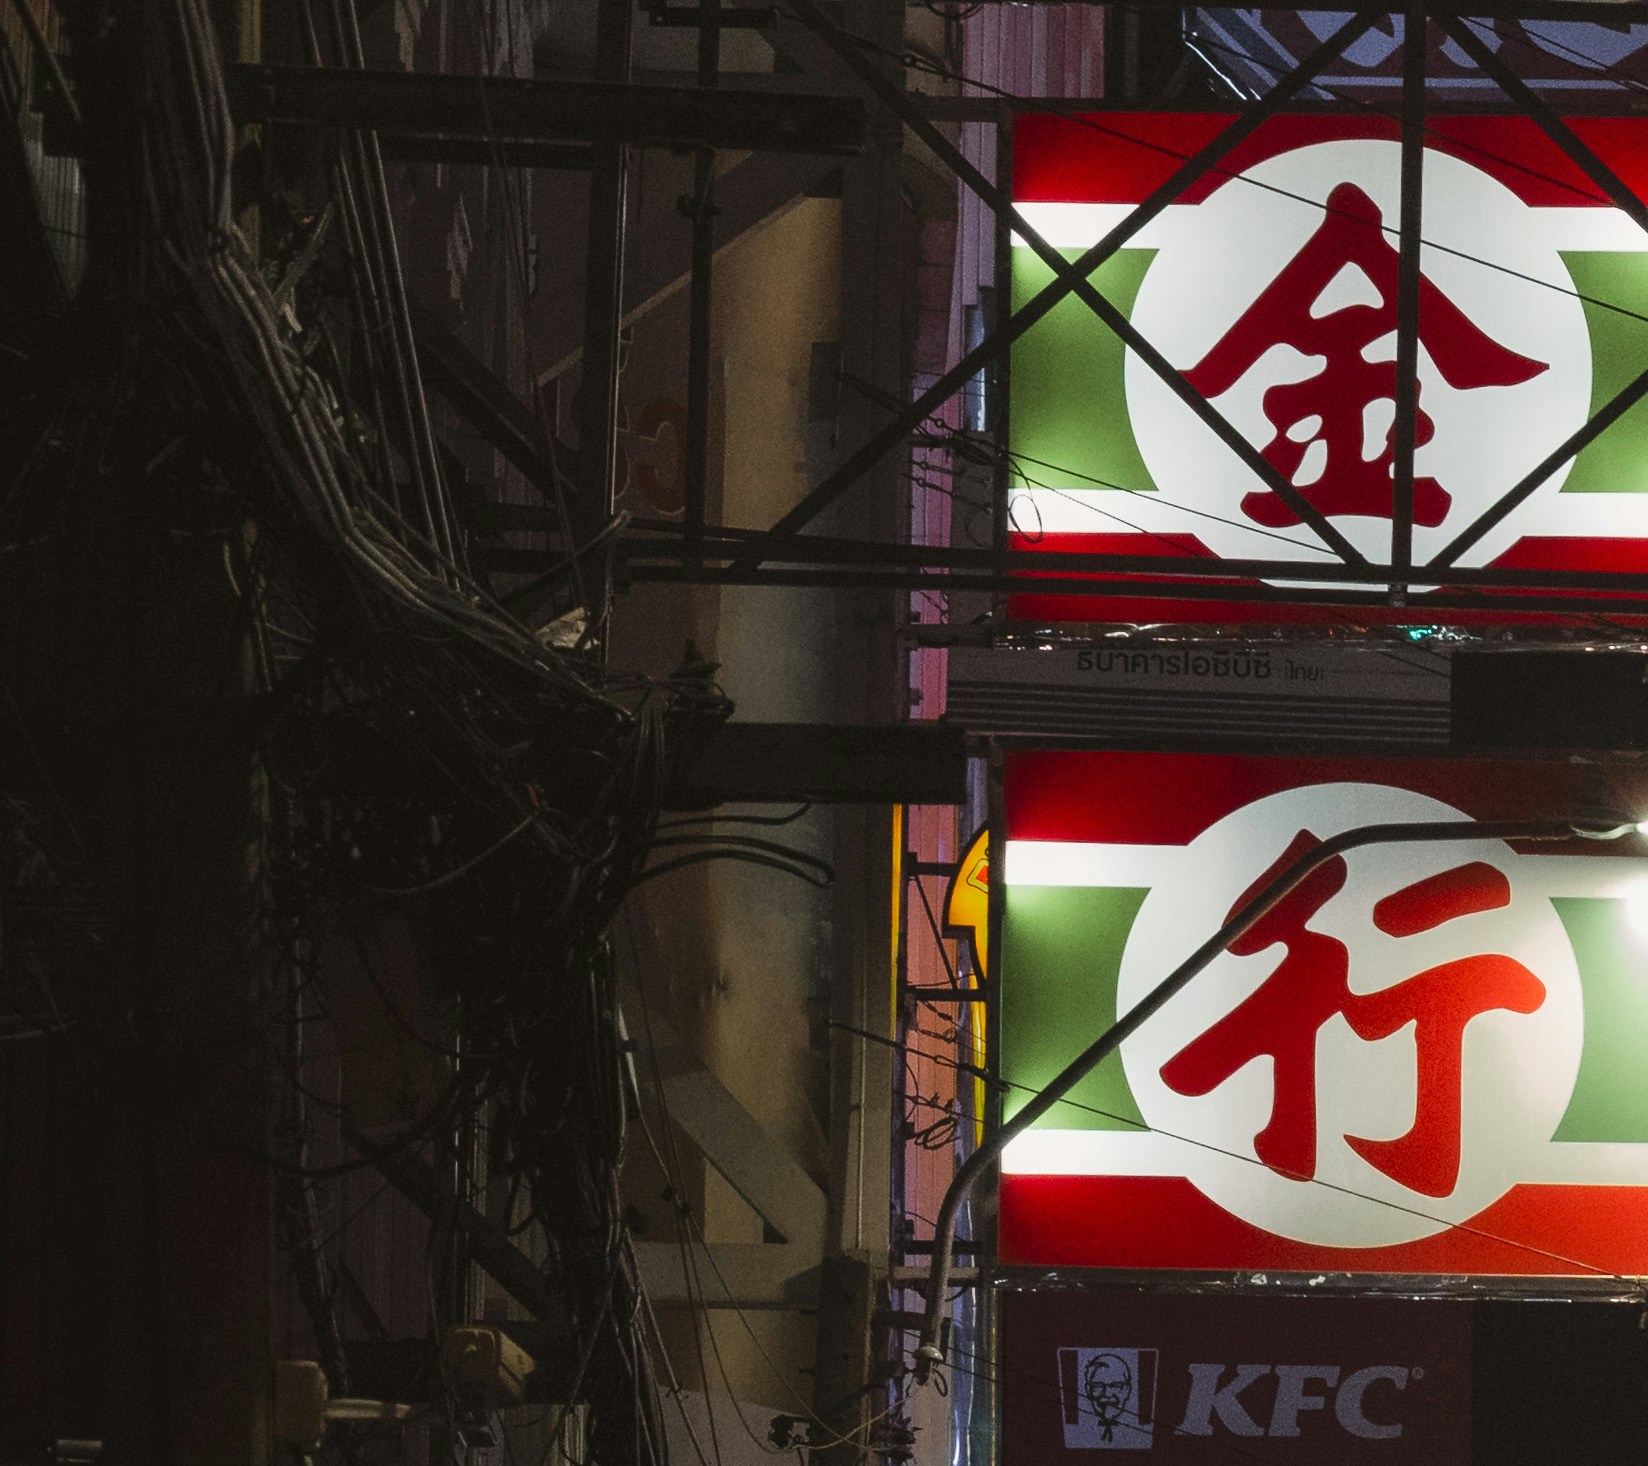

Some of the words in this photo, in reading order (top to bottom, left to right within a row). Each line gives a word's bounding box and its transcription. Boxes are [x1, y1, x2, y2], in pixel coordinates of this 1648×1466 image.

[1175, 183, 1550, 530] 金
[1160, 831, 1547, 1199] 行
[1176, 1363, 1405, 1439] KFC
